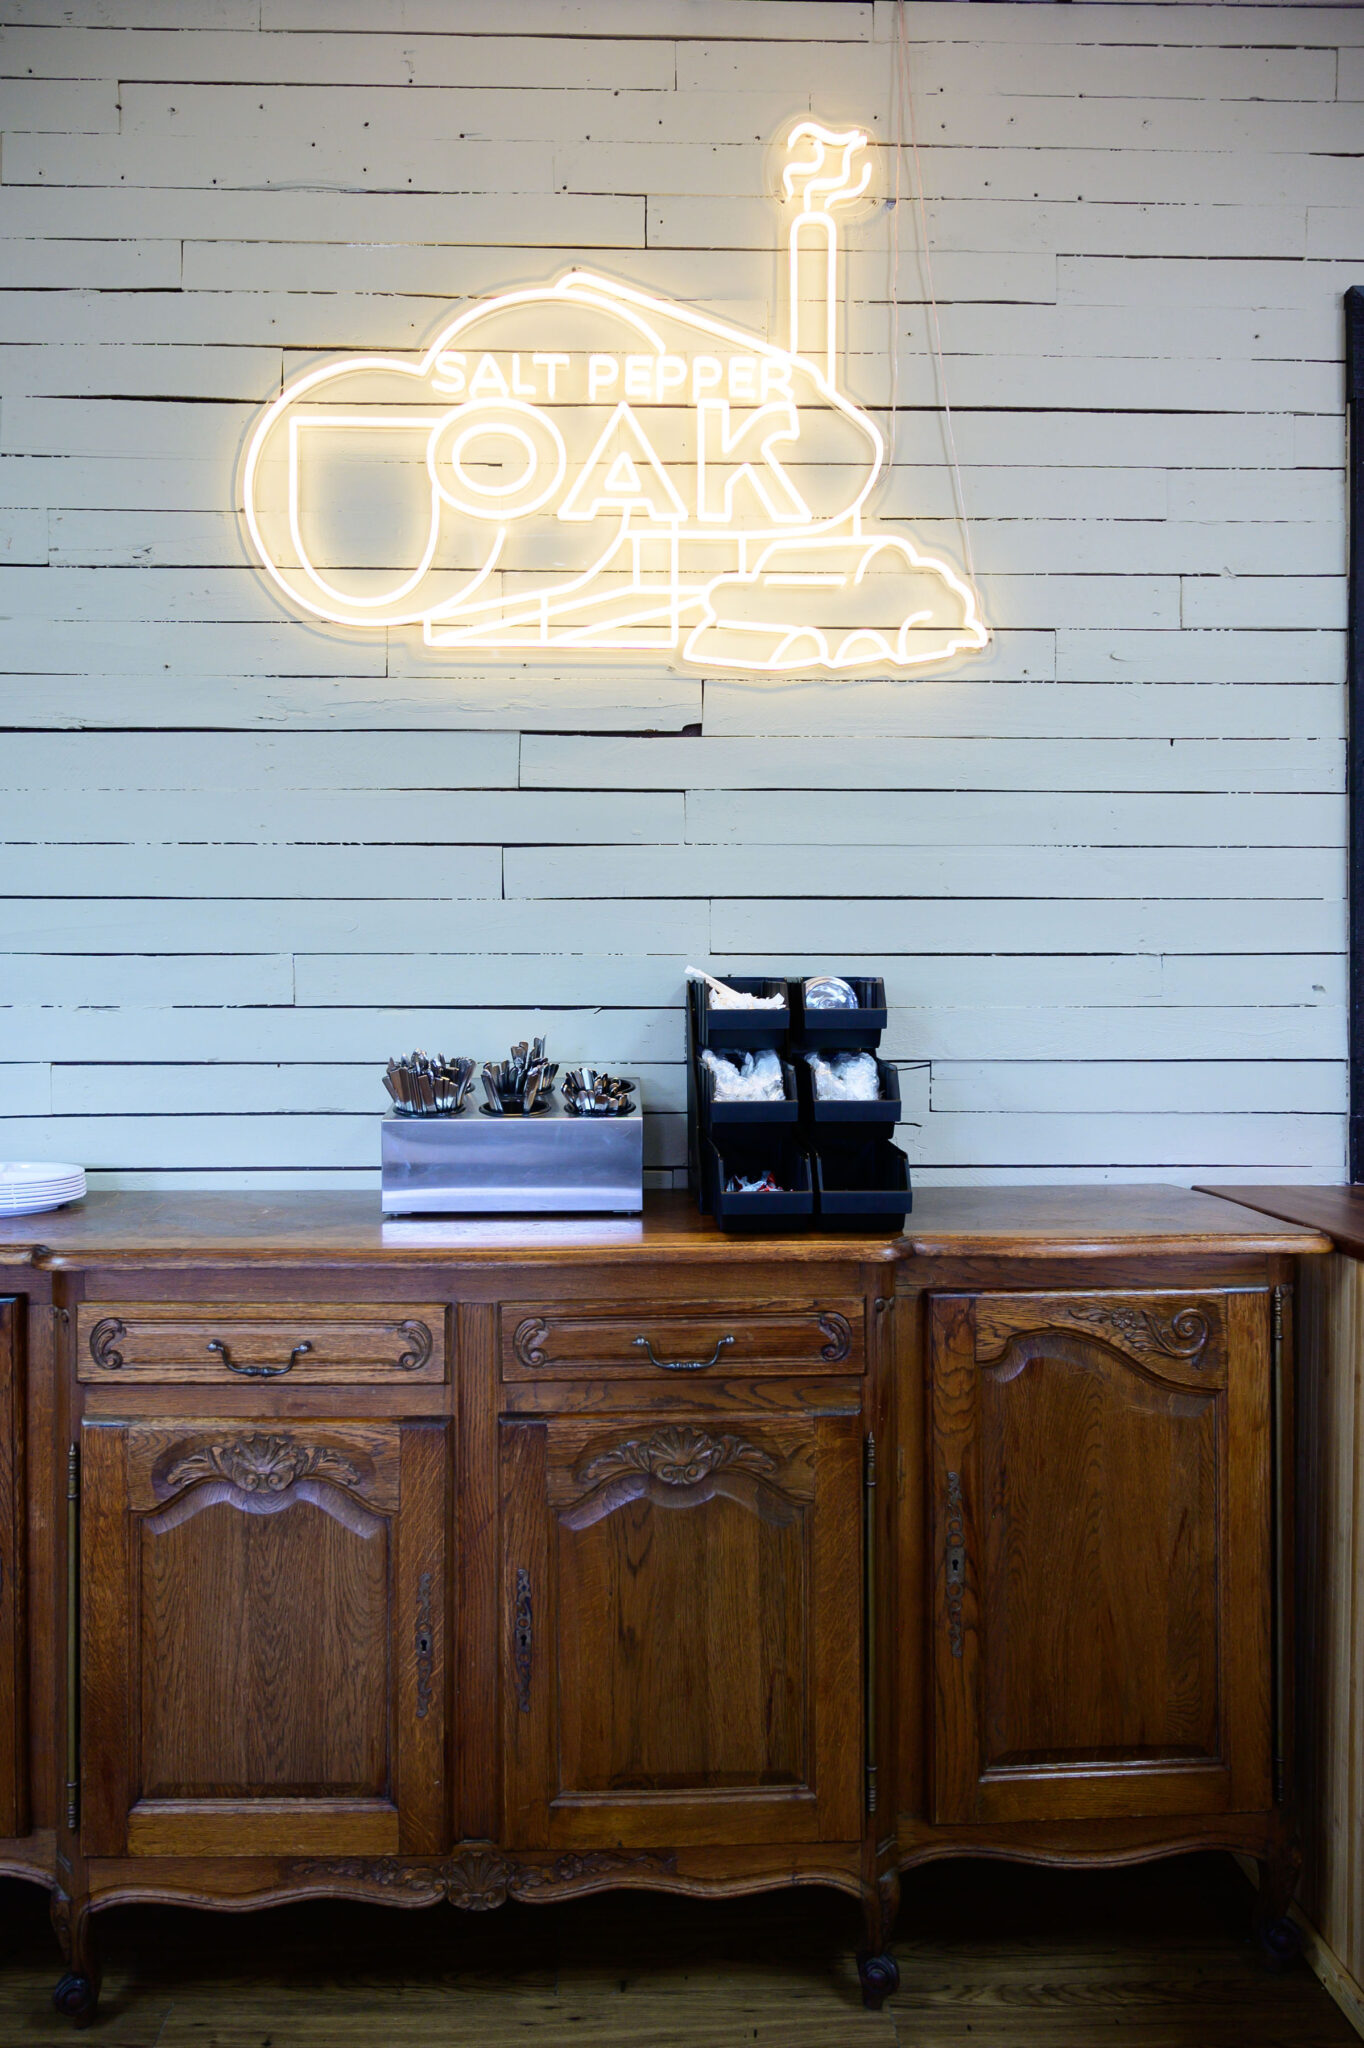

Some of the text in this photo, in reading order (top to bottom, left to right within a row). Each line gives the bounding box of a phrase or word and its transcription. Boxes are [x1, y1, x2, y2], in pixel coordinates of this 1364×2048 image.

[431, 352, 795, 399] SALT PEPPER
[427, 398, 812, 521] OAK
